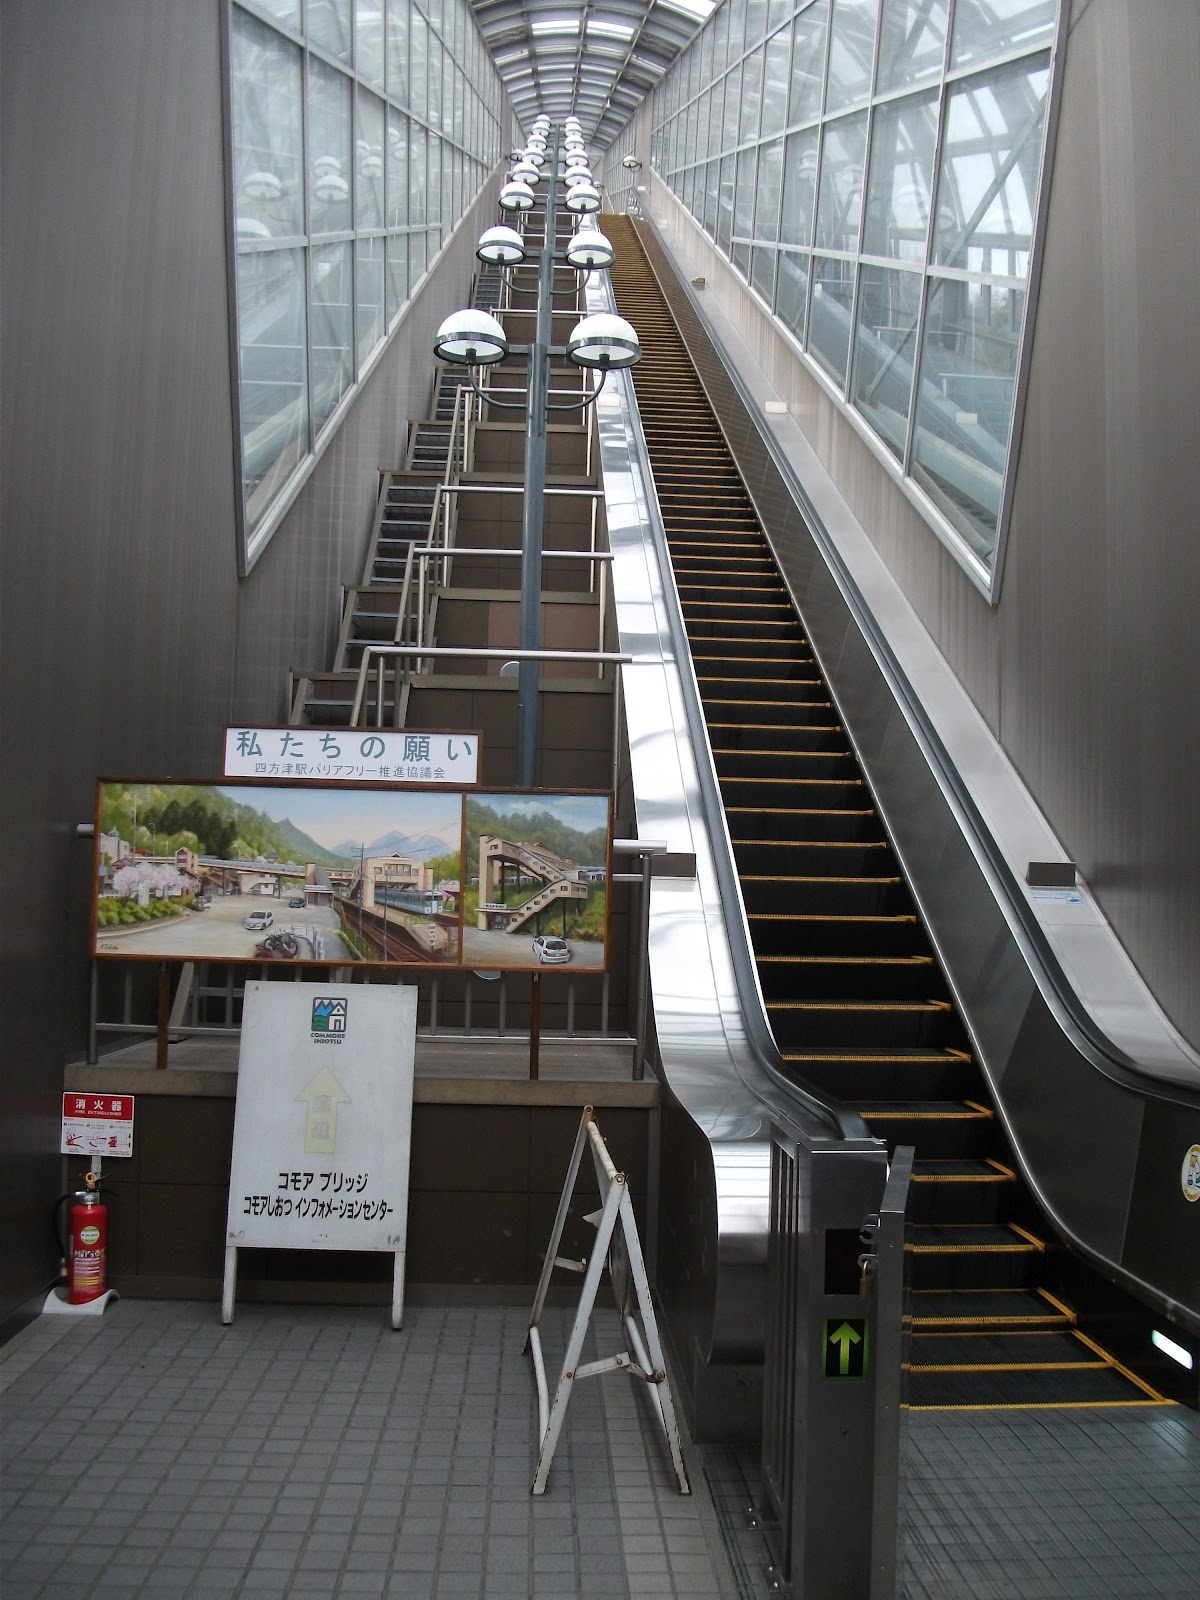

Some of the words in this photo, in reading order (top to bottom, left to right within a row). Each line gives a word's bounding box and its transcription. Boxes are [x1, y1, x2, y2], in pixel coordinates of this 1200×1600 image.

[236, 730, 473, 762] 私たちの願い
[255, 763, 446, 779] 四方津駅バリアフリー推進協議会
[75, 1098, 122, 1112] 消火器
[278, 1172, 314, 1190] コモア
[319, 1172, 369, 1193] ブリッジ
[243, 1195, 293, 1217] コモアしおつ
[295, 1197, 394, 1220] インフォメーションセンター
